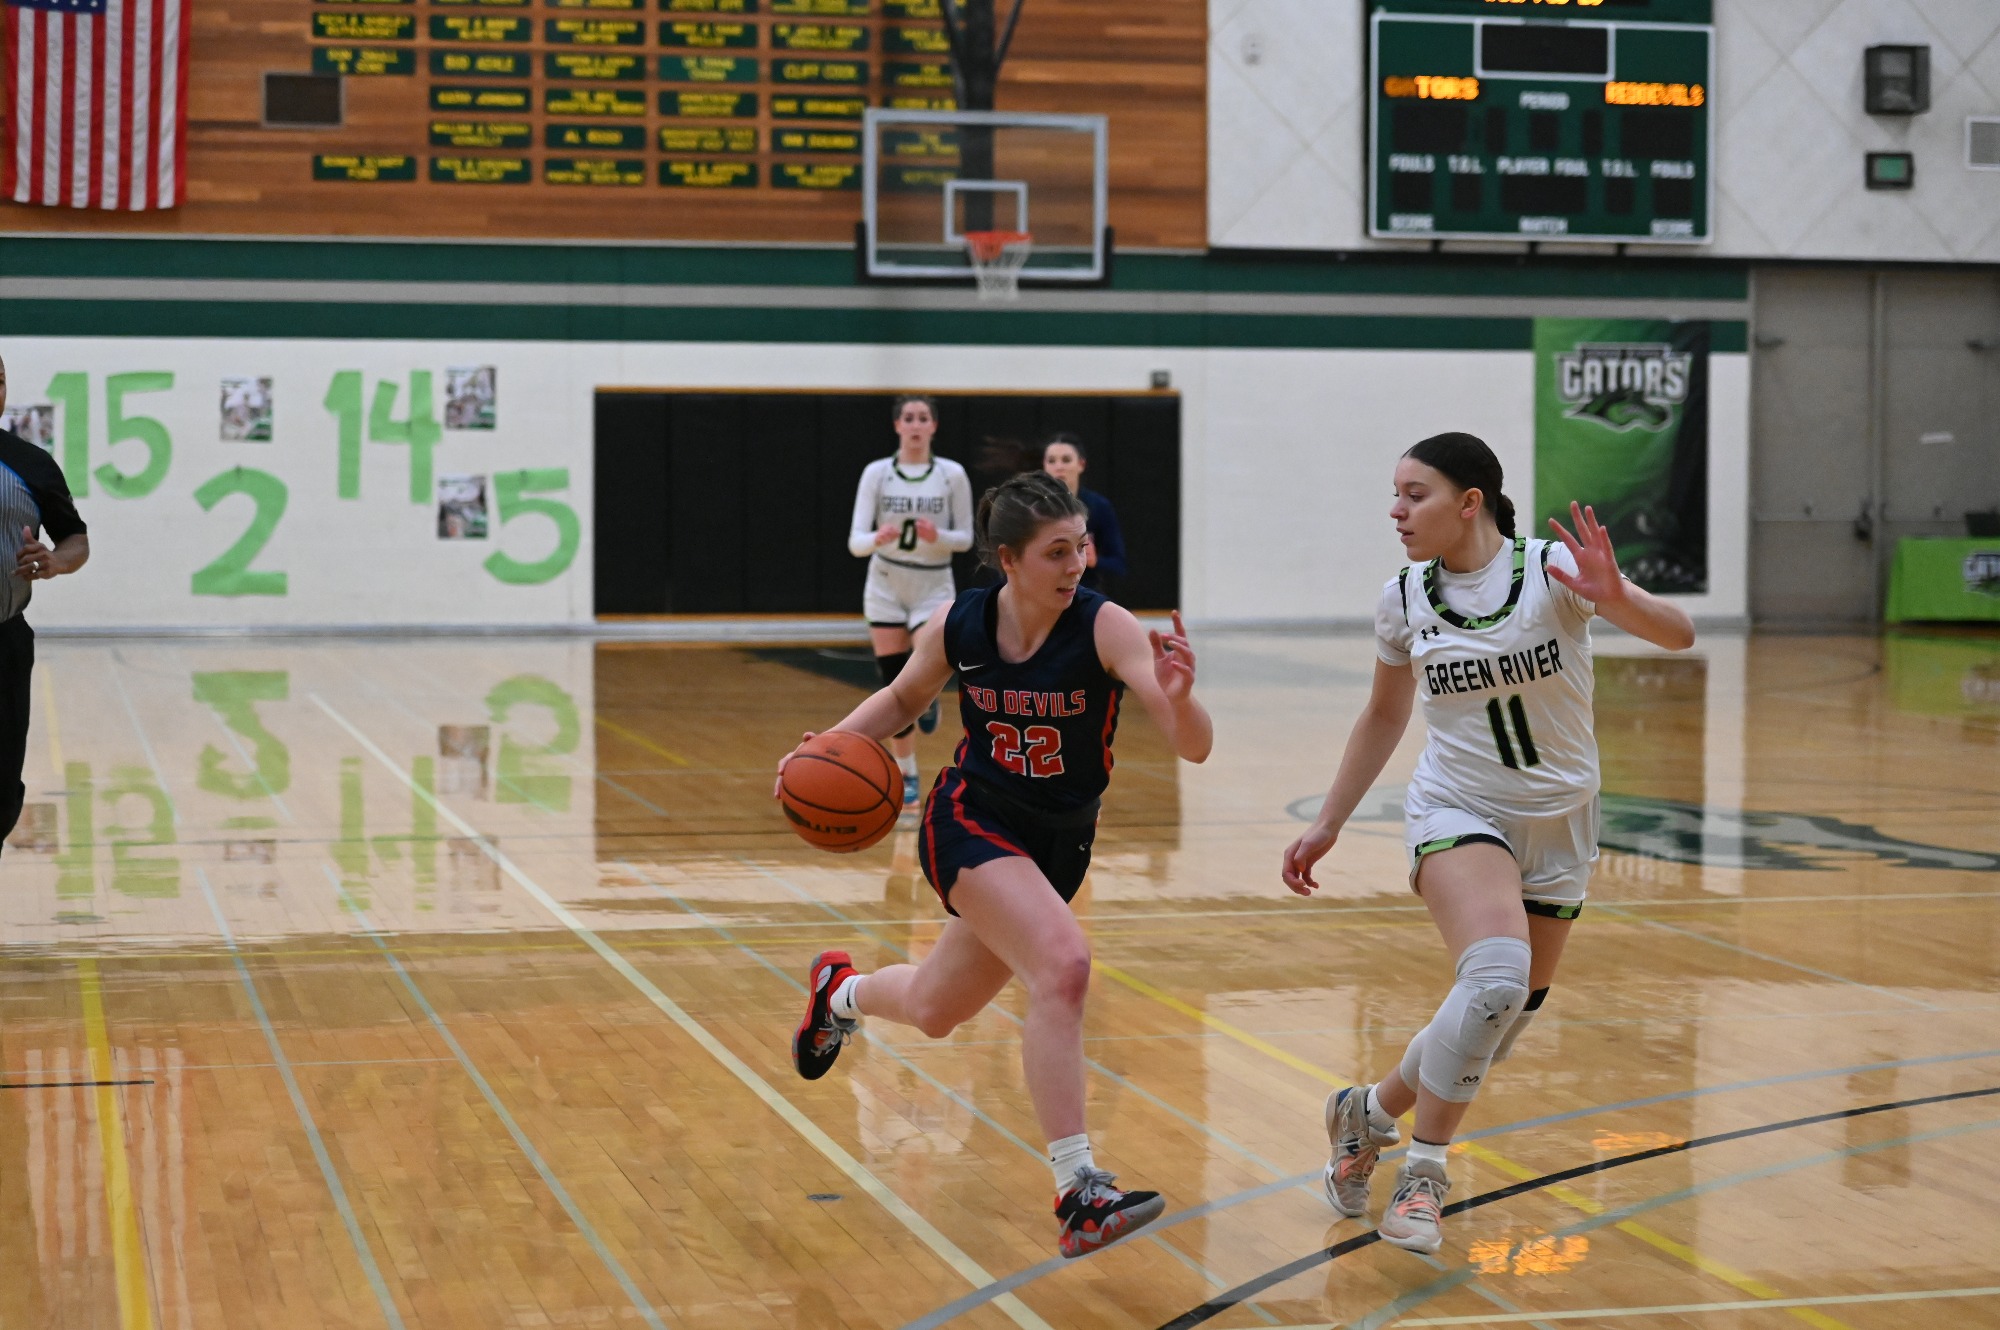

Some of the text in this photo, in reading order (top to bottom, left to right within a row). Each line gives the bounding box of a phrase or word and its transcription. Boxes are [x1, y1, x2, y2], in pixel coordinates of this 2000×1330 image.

[1496, 156, 1550, 175] PLAYER
[1562, 357, 1685, 397] GATORS
[46, 372, 174, 499] 15
[323, 370, 441, 503] 14
[192, 466, 288, 595] 2
[483, 469, 581, 585] 5
[882, 496, 912, 513] GREEN
[899, 518, 917, 552] 0
[1425, 638, 1563, 695] GREEN RIVER
[1004, 690, 1086, 717] DEVILS
[1486, 694, 1541, 769] 11
[986, 721, 1065, 778] 22
